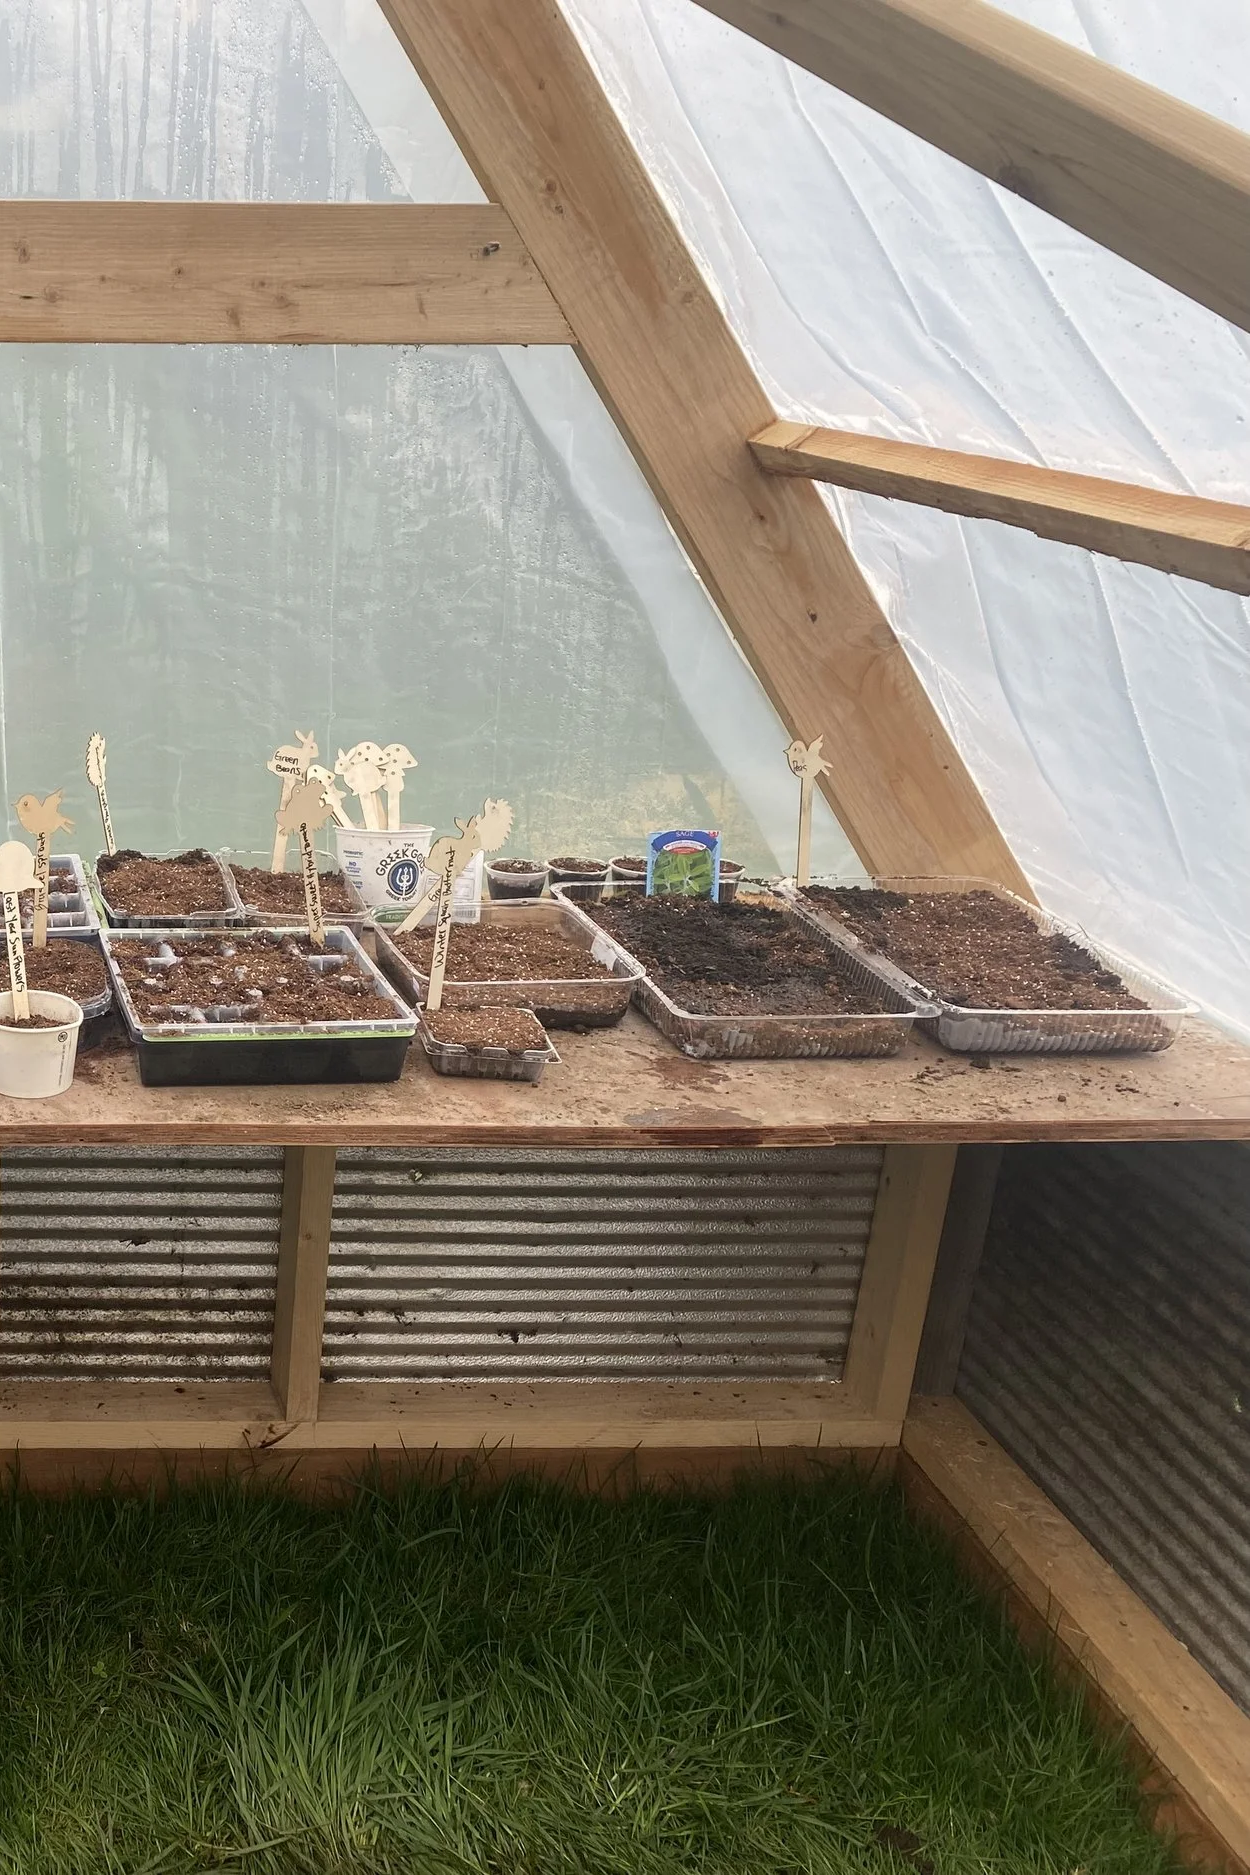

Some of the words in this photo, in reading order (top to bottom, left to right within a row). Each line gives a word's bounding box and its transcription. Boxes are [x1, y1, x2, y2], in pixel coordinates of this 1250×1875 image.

[274, 750, 299, 766] Green
[276, 764, 301, 776] Beans
[792, 760, 808, 772] Peas
[4, 892, 16, 914] Last
